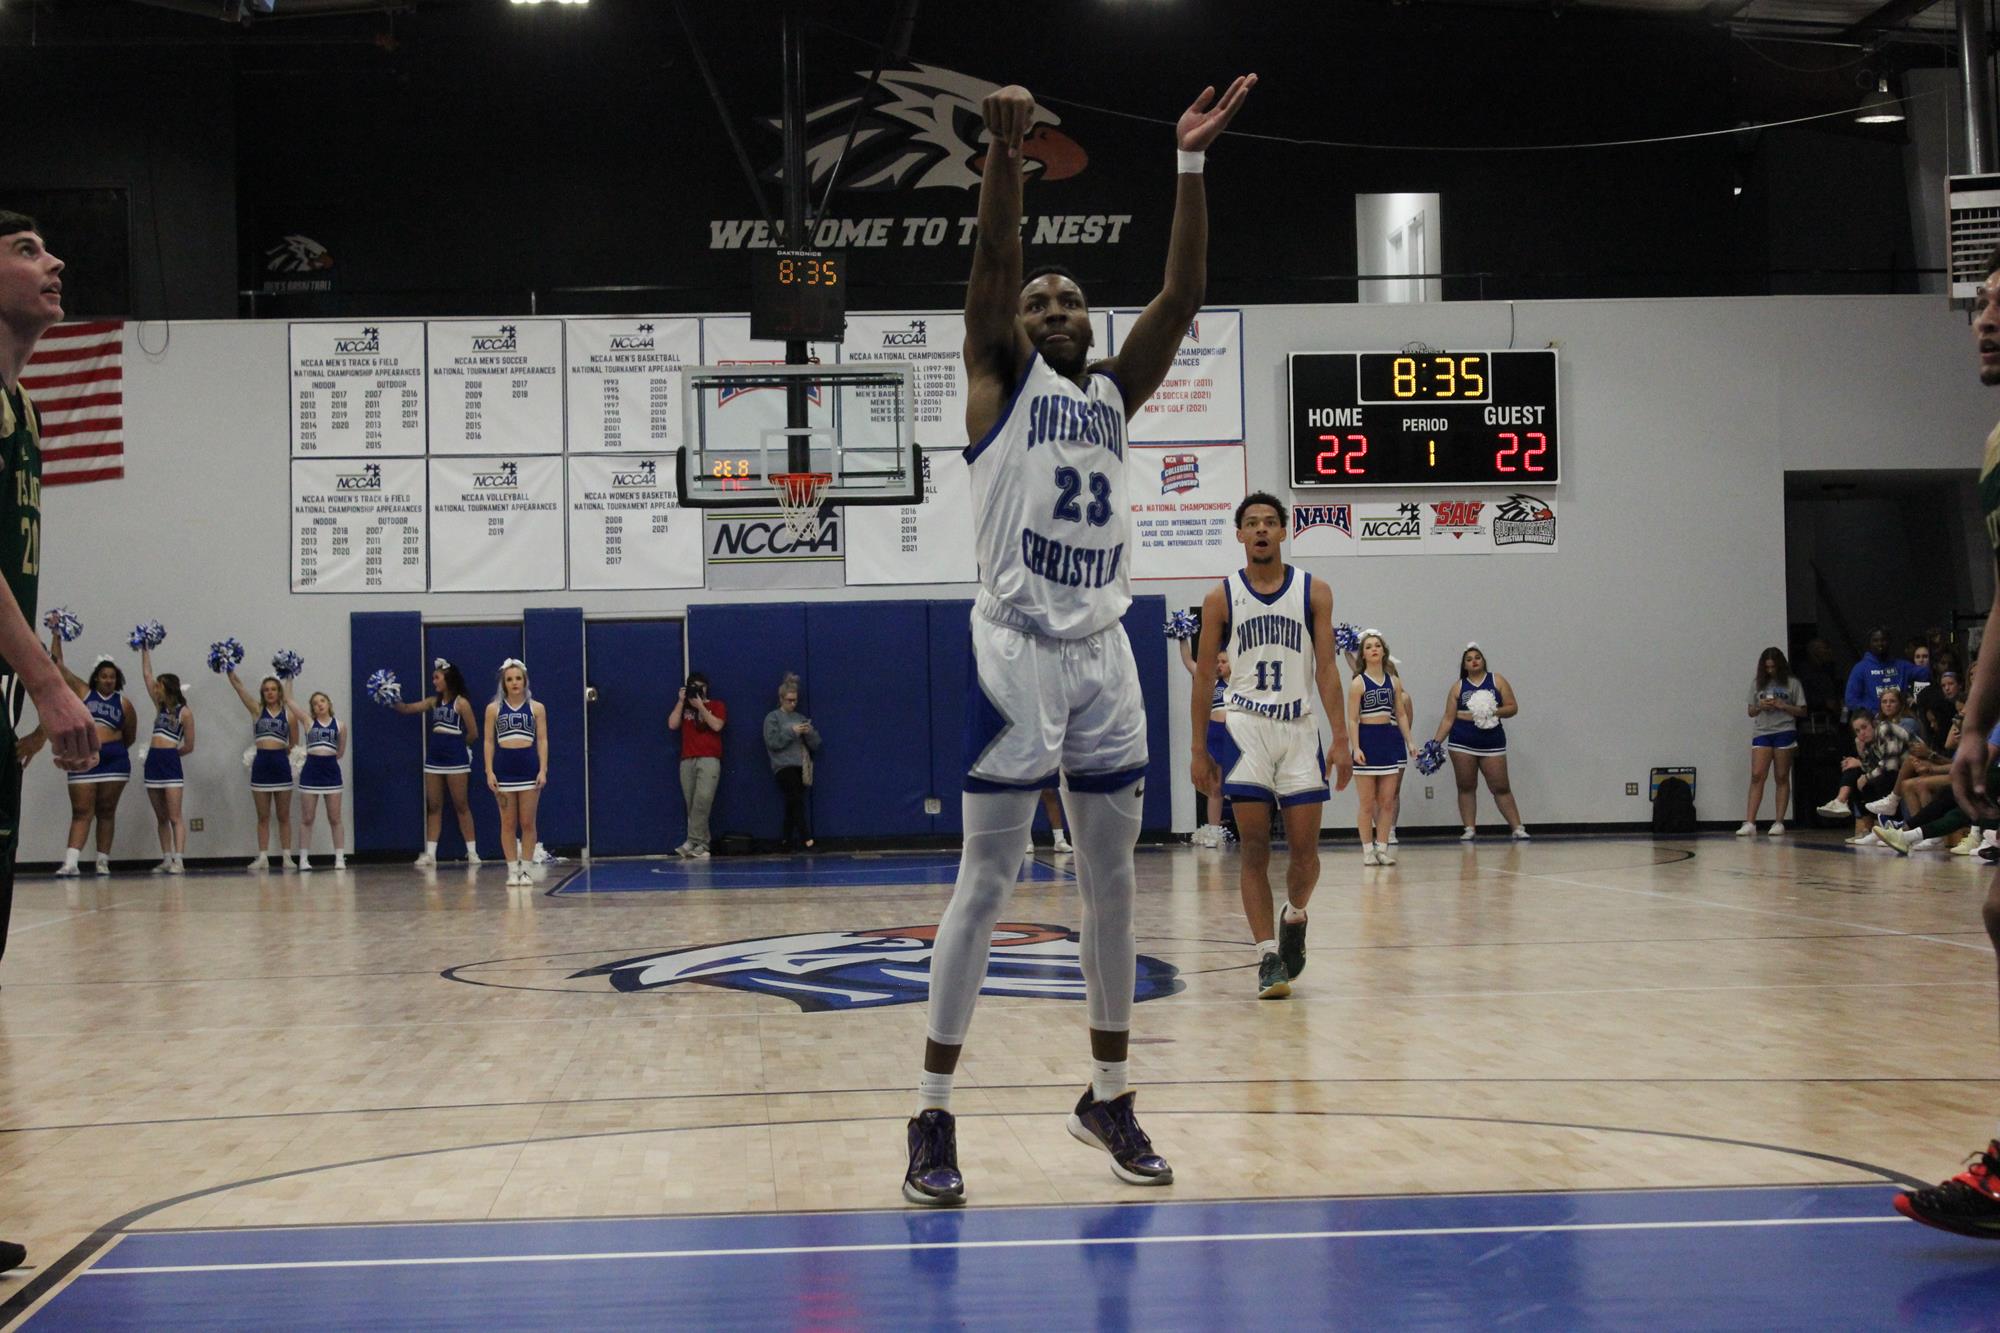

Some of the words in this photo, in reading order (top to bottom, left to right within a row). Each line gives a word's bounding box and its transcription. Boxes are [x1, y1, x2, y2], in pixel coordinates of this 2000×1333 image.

[709, 216, 894, 249] WEOME
[902, 218, 948, 245] TO
[1032, 215, 1132, 244] NEST
[780, 260, 837, 285] 8:35
[610, 338, 654, 348] NCCAA
[883, 334, 926, 344] NCCAA
[336, 341, 379, 351] NCCAA
[473, 339, 516, 350] NCCAA
[874, 352, 906, 360] NATIONAL
[909, 352, 960, 360] CHAMPIONSHIPS
[380, 358, 398, 366] FIELD
[375, 368, 420, 376] APPEARANCES
[467, 367, 507, 375] TOURNAMENT
[1393, 357, 1483, 397] 8:35
[1194, 379, 1213, 387] (2011)
[402, 410, 417, 418] 2019
[1145, 405, 1165, 413] MEN'S
[1308, 408, 1363, 426] HOME
[1484, 406, 1545, 425] GUEST
[1403, 418, 1448, 432] PERIOD
[366, 441, 381, 449] 2015
[1317, 435, 1367, 474] 22
[1430, 440, 1434, 466] 1
[1496, 433, 1546, 471] 22
[338, 478, 380, 488] NCCAA
[474, 476, 517, 486] NCCAA
[613, 475, 655, 485] NCCAA
[1053, 465, 1113, 527] 23
[1131, 504, 1143, 512] NCA
[1180, 502, 1232, 511] CHAMPIONSHIPS
[1435, 501, 1481, 524] SAC
[378, 517, 408, 525] OUTDOOR
[1295, 507, 1349, 533] NAIA
[1361, 522, 1420, 536] NCCAA
[366, 557, 382, 565] 2013
[1254, 661, 1283, 692] 11
[497, 713, 535, 733] SCU
